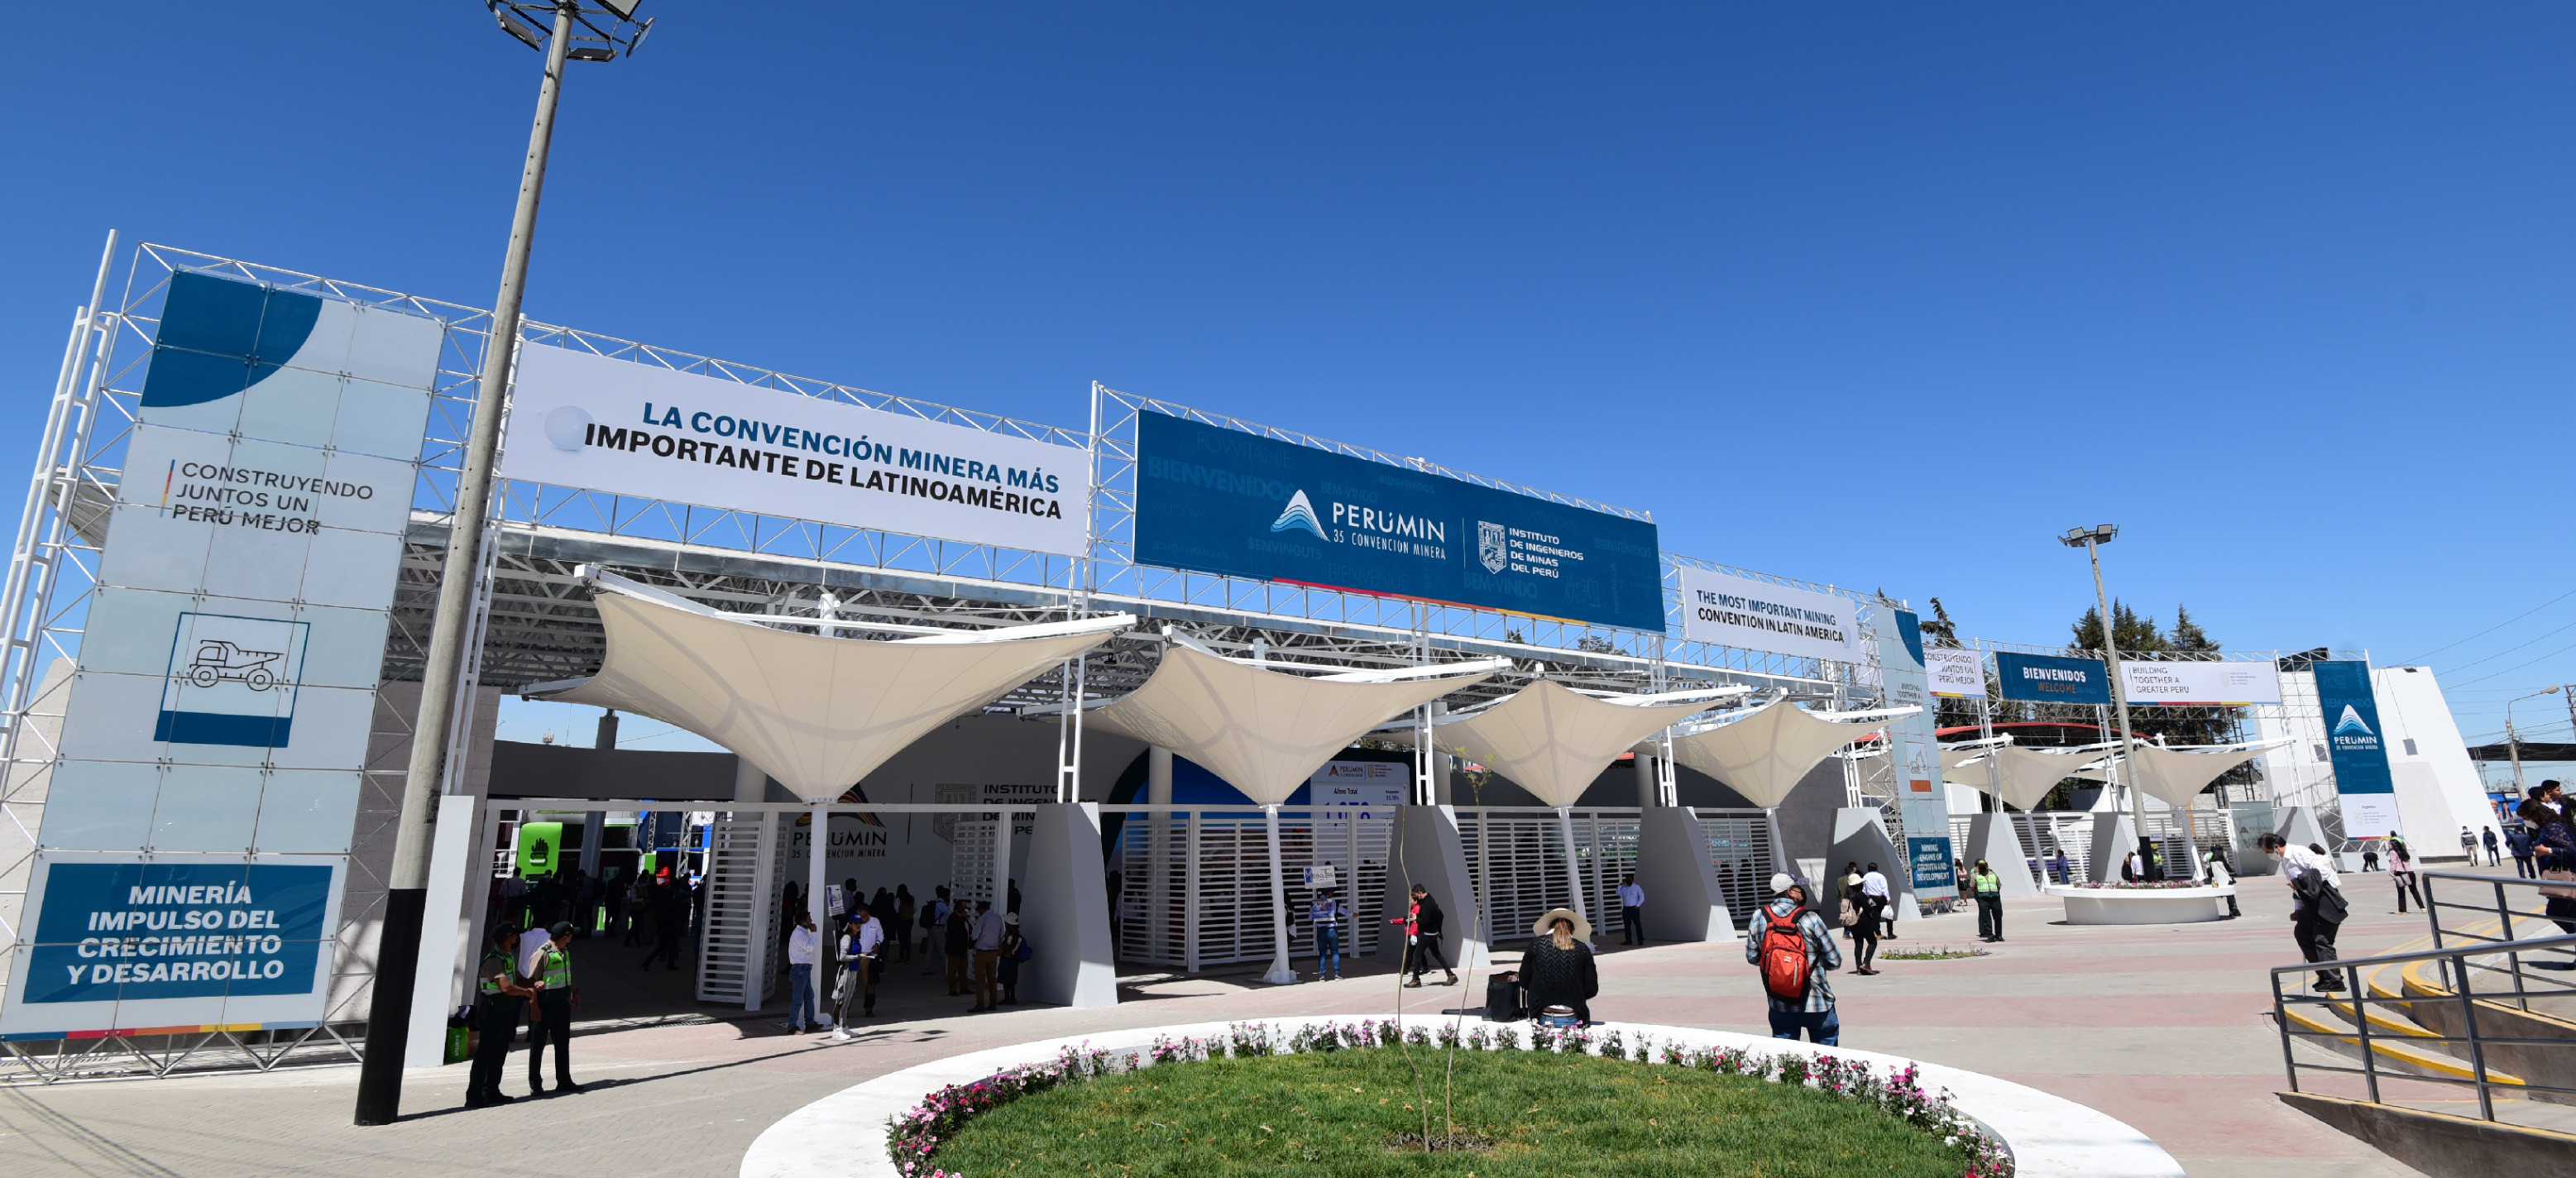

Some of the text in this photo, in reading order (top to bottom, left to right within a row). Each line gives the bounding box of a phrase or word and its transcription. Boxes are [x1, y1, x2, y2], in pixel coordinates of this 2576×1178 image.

[643, 401, 1060, 494] LA CONVENCIÓN MINERA MÁS
[1197, 431, 1290, 467] POWITANIE
[181, 462, 373, 500] CONSTRUYENDO
[584, 424, 1062, 520] IMPORTANTE DE LATINOAMÉRICA
[1147, 456, 1297, 502] BIENVENIDOS
[1320, 482, 1378, 503] BEM-VINDO
[1378, 474, 1435, 494] BIENVENIDOS
[176, 483, 309, 512] JUNTOS UN
[172, 502, 319, 535] PERÚ MEJOR
[1333, 529, 1344, 543] 35
[1413, 543, 1446, 560] MINERA
[1509, 528, 1559, 544] INSTITUTO
[1510, 539, 1583, 560] DE INGENIEROS
[1511, 551, 1524, 561] DE
[1526, 553, 1559, 567] MINAS
[1511, 563, 1559, 578] DEL PERÚ
[1463, 572, 1537, 600] BEM-VINDO
[1697, 590, 1836, 625] THE MOST IMPORTANT MINING
[1698, 607, 1844, 643] CONVENTION IN LATIN AMERICA
[1923, 653, 1971, 663] CONSTRUYENDO
[1942, 665, 1974, 674] JUNTOS UN
[2023, 667, 2086, 682] BIENVENIDOS
[1956, 676, 1975, 685] MEJOR
[2037, 682, 2076, 693] WELCOME
[984, 784, 1058, 794] INSTITUTO
[1011, 812, 1036, 821] MIN
[792, 850, 801, 858] 35
[858, 849, 885, 857] MINERA
[1917, 872, 1949, 881] DEVELOPMENT
[1918, 863, 1937, 871] GROWTH
[129, 879, 251, 905] MINERÍA
[89, 910, 280, 931] IMPULSO DEL
[78, 935, 281, 959] CRECIMIENTO
[67, 960, 284, 984] Y DESARROLLO
